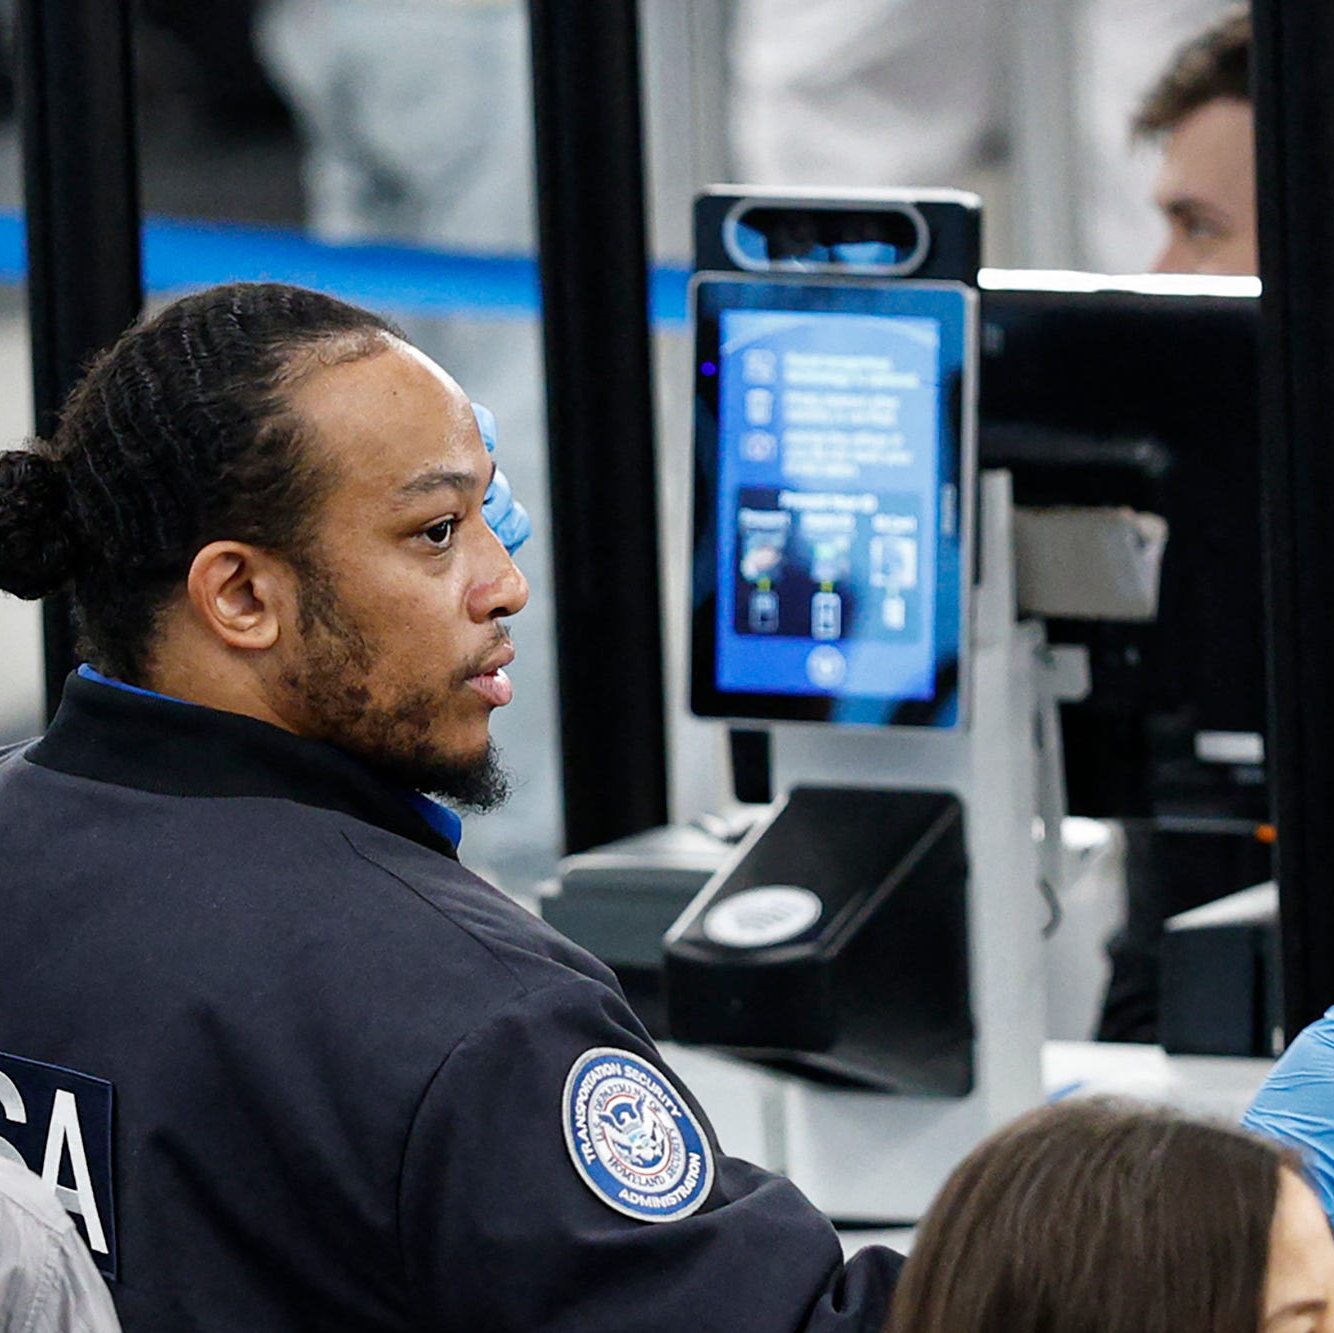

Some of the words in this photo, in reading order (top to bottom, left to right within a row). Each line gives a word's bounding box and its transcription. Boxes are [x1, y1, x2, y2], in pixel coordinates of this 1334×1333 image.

[574, 1062, 623, 1166] TRANSPORTATION
[623, 1063, 682, 1118] SECURITY
[608, 1155, 666, 1187] HOMELAND
[618, 1151, 702, 1208] ADMINISTRATION
